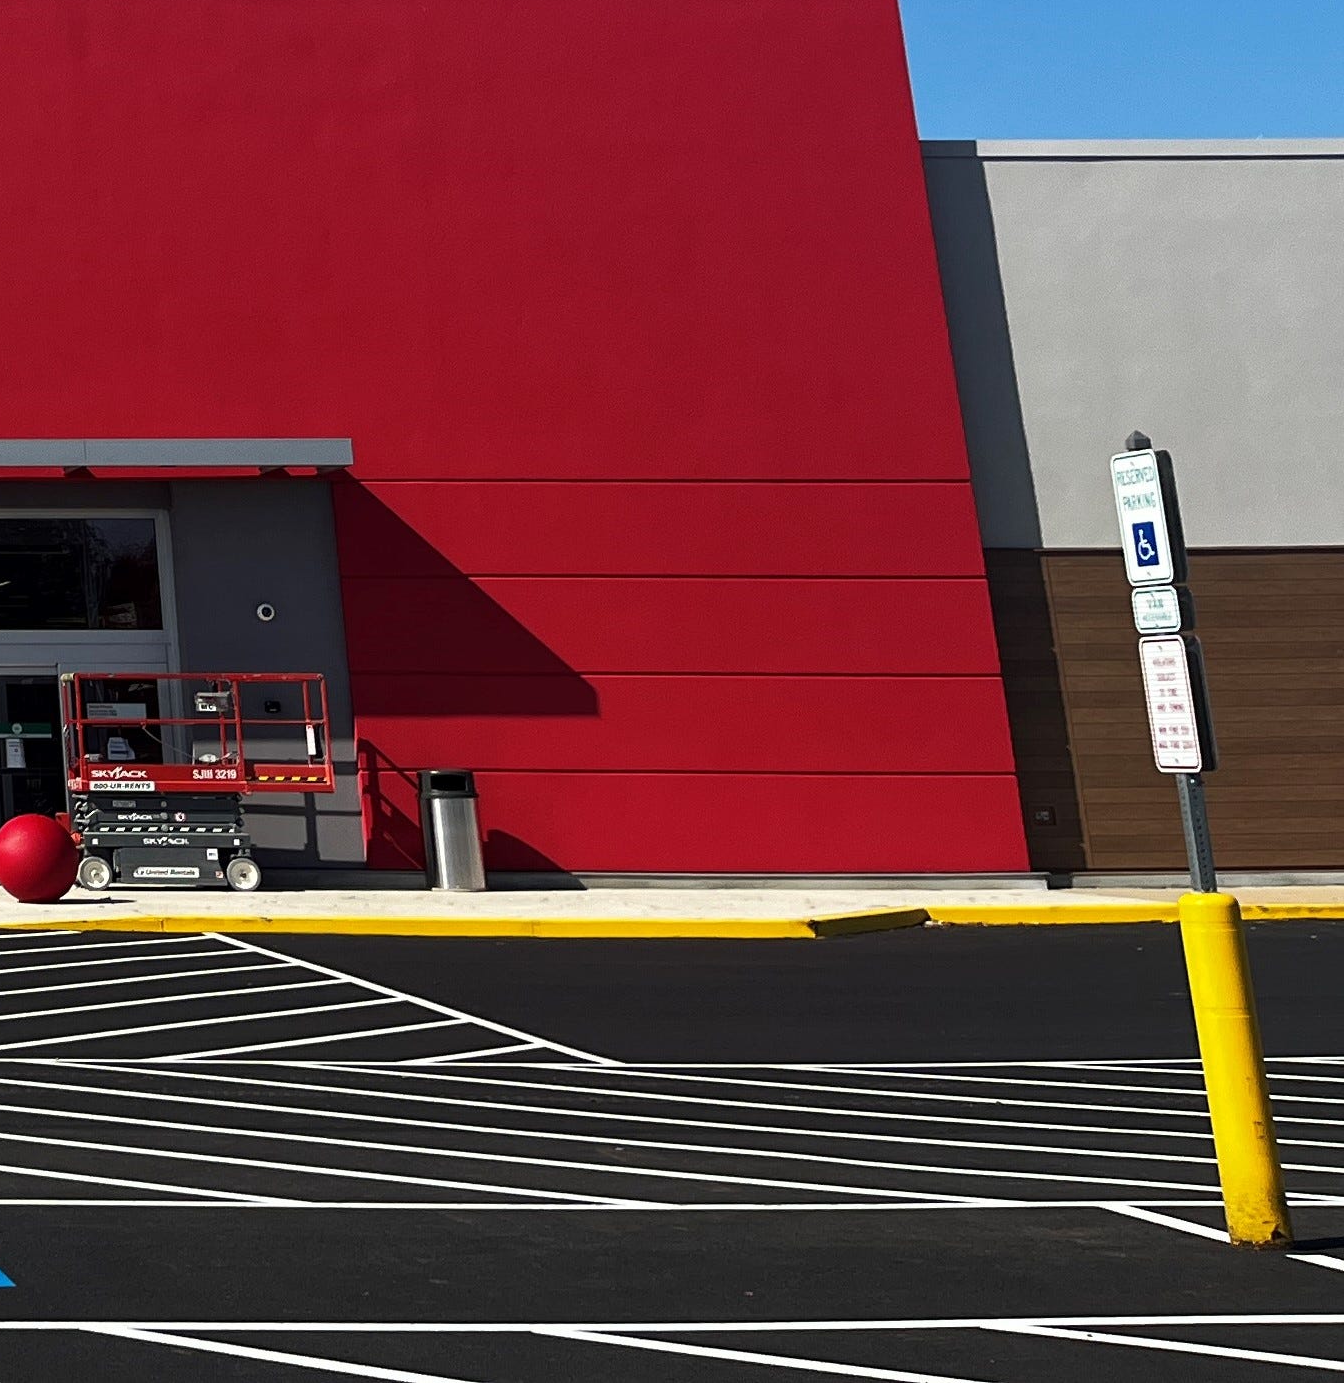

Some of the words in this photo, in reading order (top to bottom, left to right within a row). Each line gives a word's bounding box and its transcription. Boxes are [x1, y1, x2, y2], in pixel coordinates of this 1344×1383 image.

[1116, 466, 1155, 486] RESERVED
[1122, 492, 1156, 511] PARKING
[90, 766, 148, 780] SKYJACK
[215, 769, 237, 780] 3219
